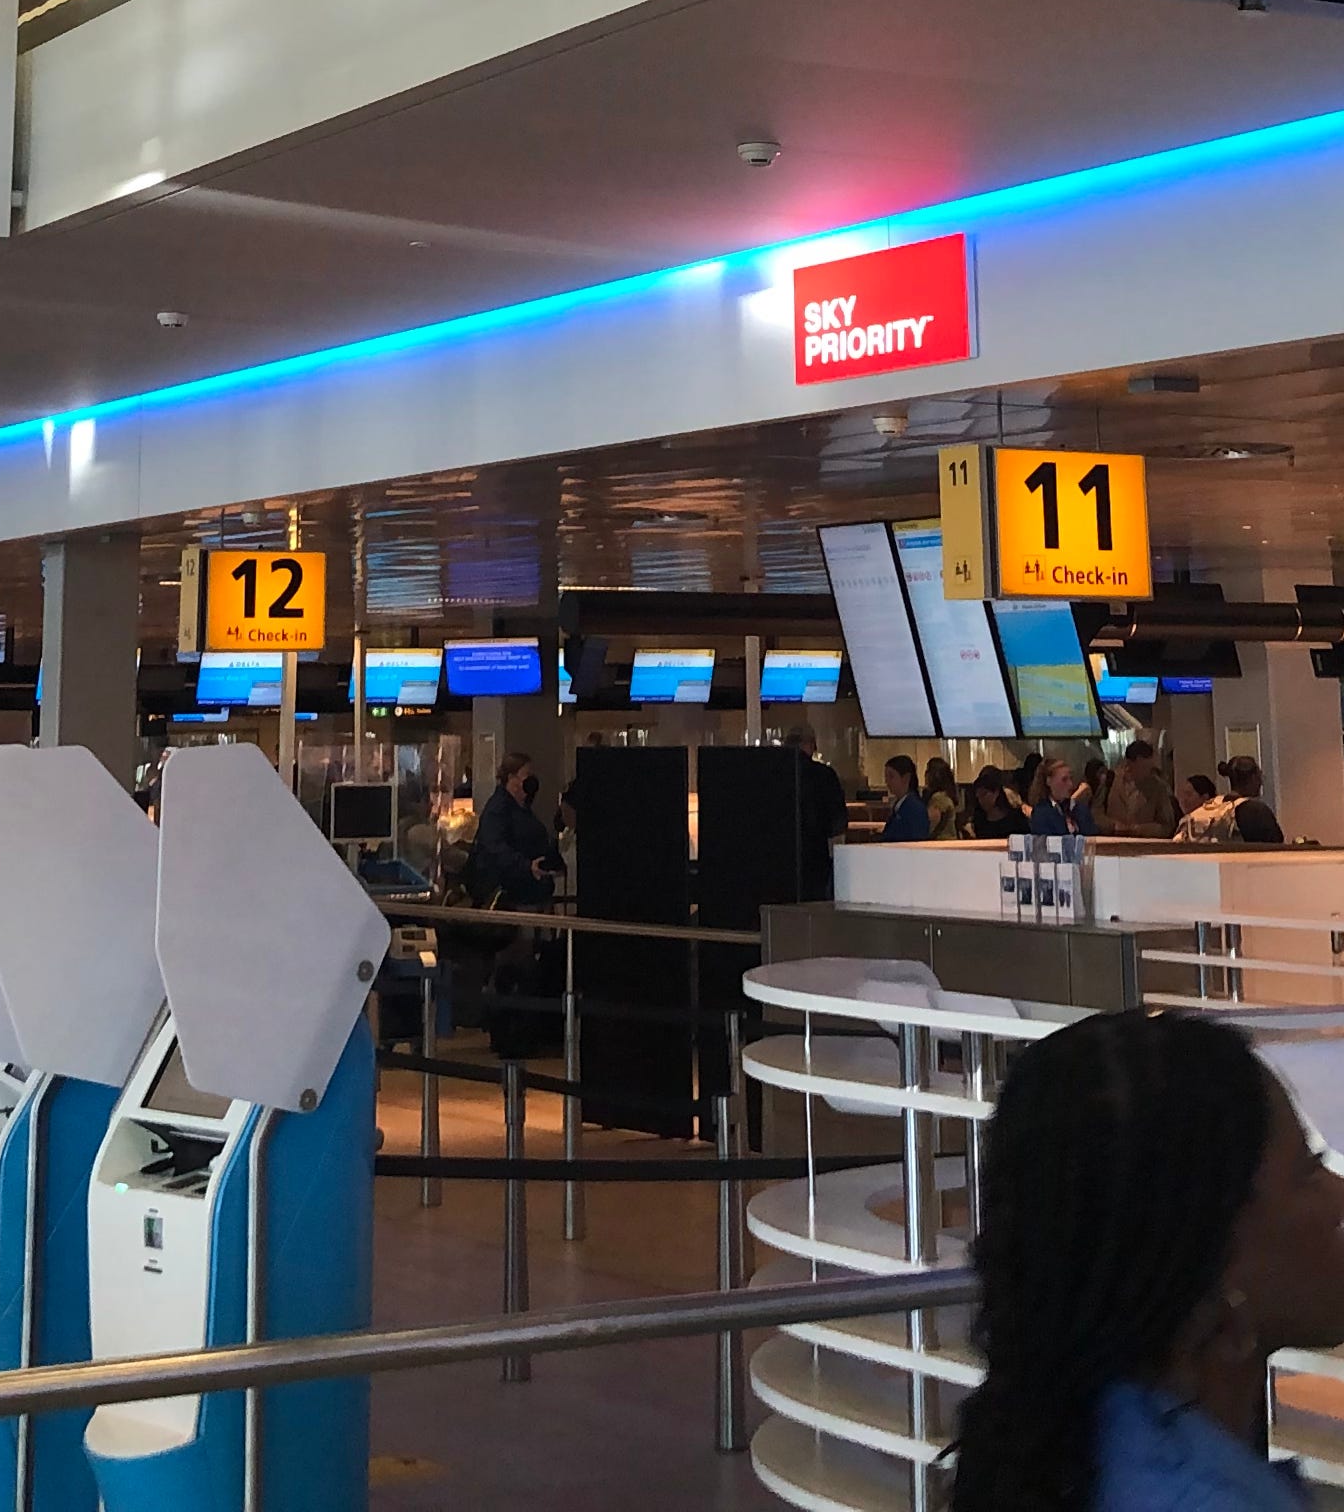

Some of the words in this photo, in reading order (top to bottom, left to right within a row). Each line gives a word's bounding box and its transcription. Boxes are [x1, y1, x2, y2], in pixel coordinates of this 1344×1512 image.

[803, 294, 857, 334] SKY
[948, 459, 968, 487] 11
[1024, 461, 1114, 551] 11
[185, 559, 196, 577] 12
[1052, 565, 1129, 586] Check-in
[231, 558, 305, 618] 12
[248, 628, 308, 642] Check-in
